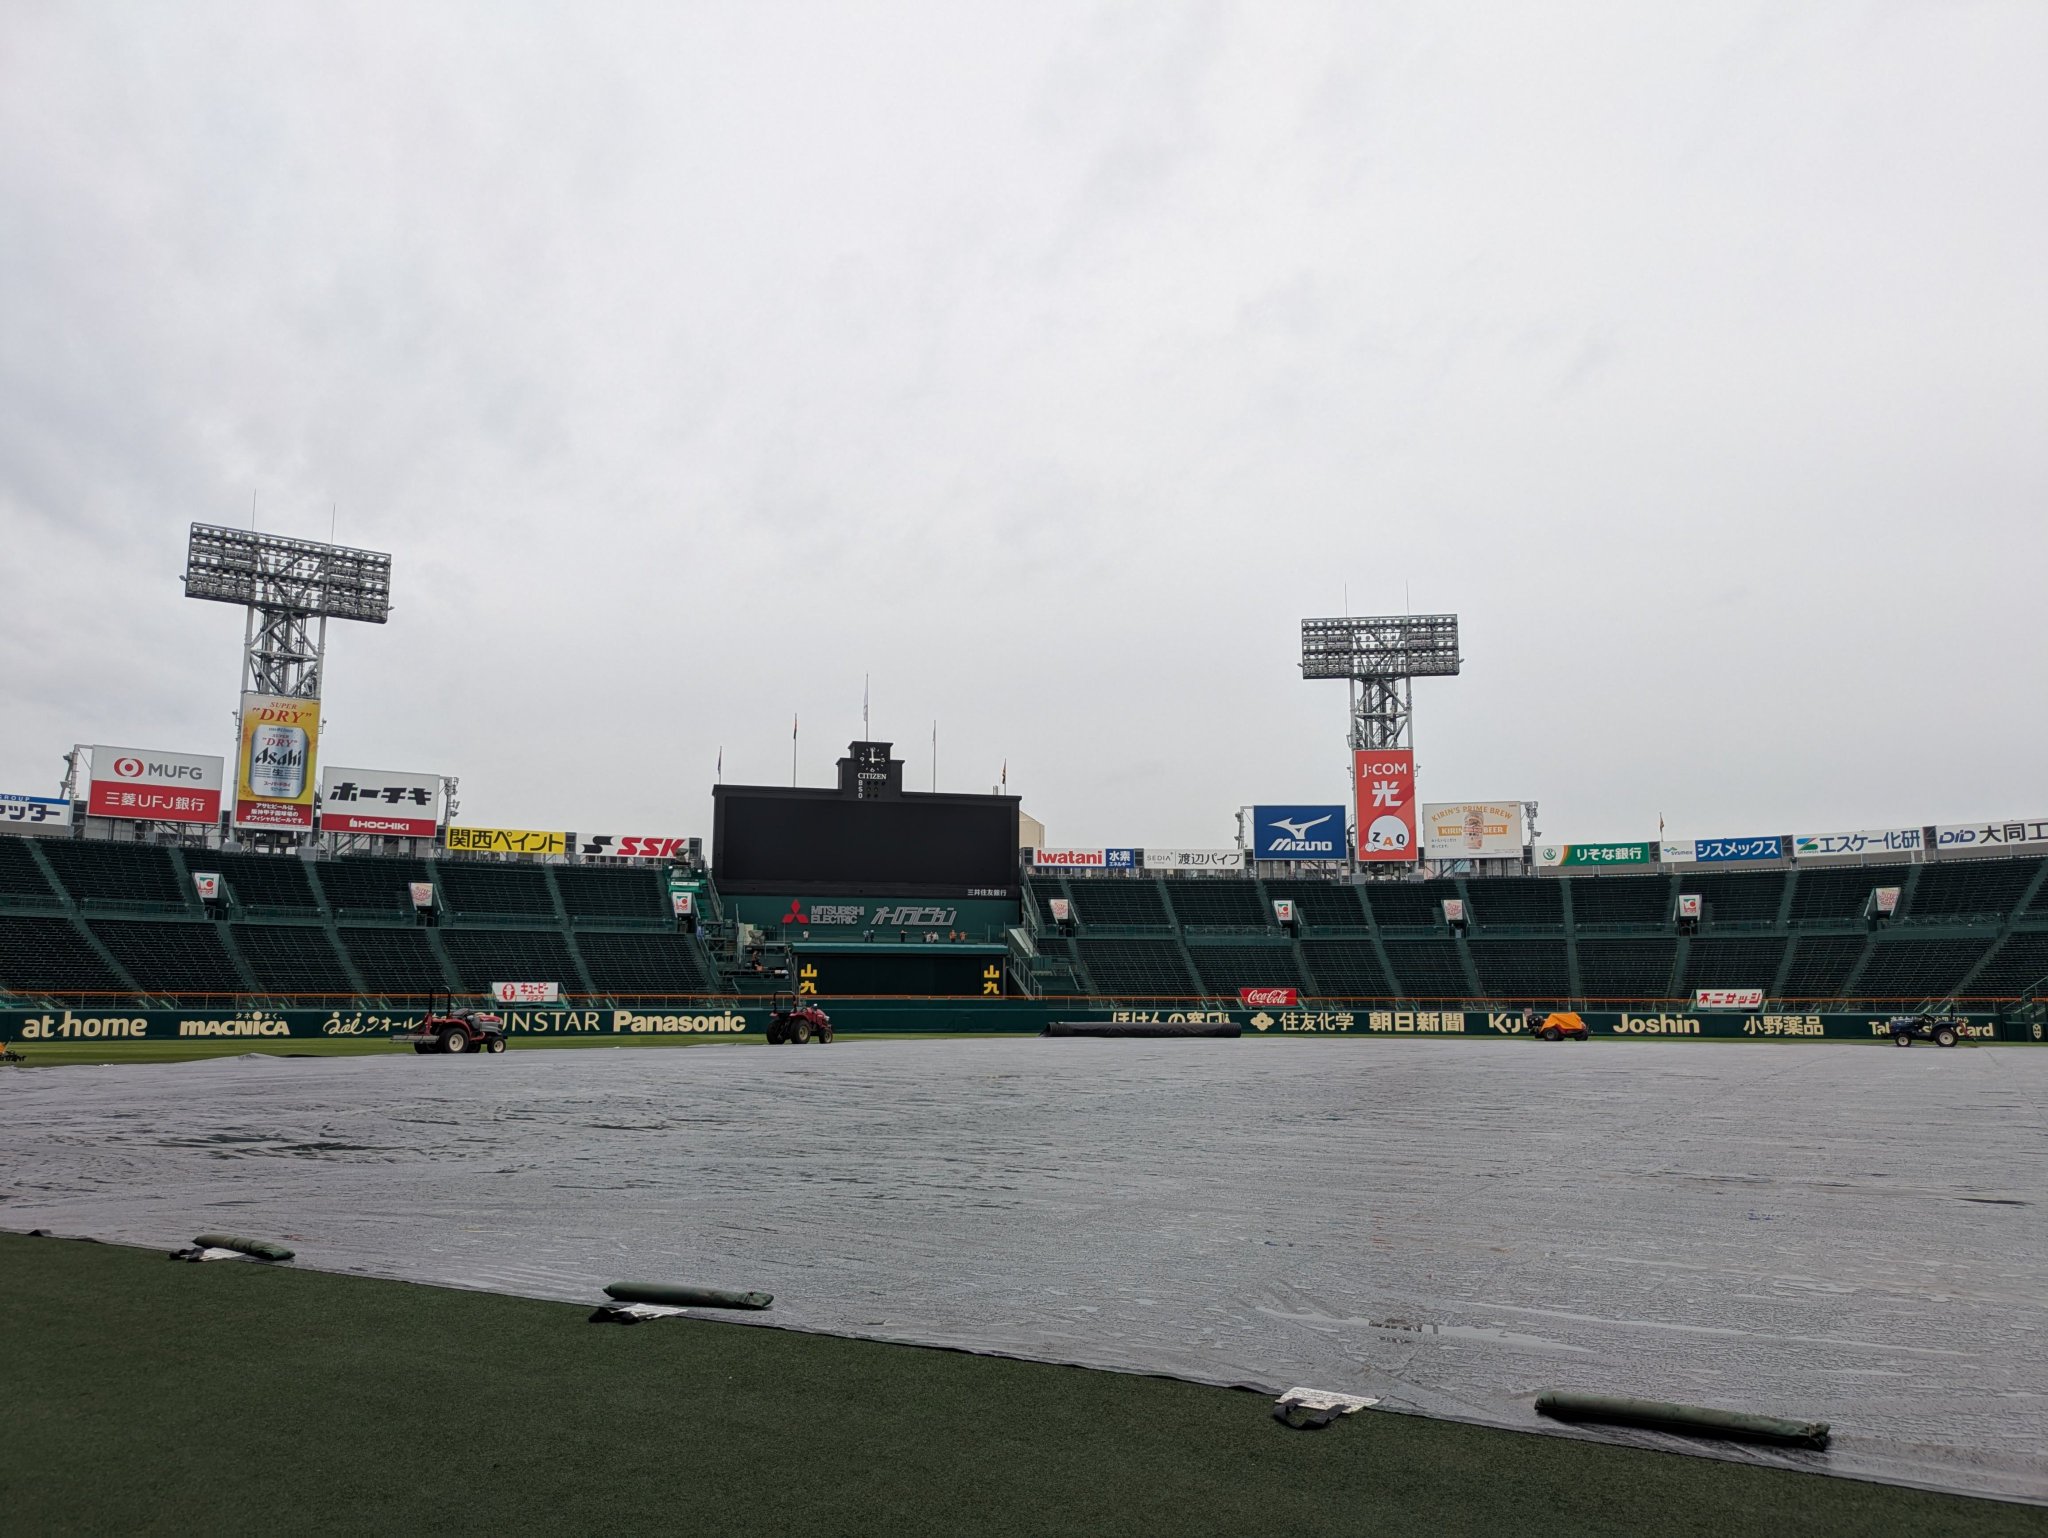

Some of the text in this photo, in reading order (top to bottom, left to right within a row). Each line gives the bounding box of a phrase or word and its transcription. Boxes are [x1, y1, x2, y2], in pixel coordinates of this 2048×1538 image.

[270, 701, 298, 710] SUPER
[255, 746, 302, 766] Asahi
[148, 763, 203, 780] MUFG
[857, 772, 887, 780] CITIZEN
[1362, 763, 1407, 777] J:COM
[0, 794, 30, 802] ROUP
[105, 791, 206, 812] 三菱UFJ銀行
[330, 782, 432, 806] ホーチキ
[1372, 780, 1403, 807] 光
[1431, 805, 1513, 822] KIRIN'S PRIME BREW
[358, 821, 409, 831] HOCHIKI
[1979, 821, 2048, 844] 大同工
[449, 828, 564, 853] 関西ペイント
[616, 837, 685, 857] SSK
[1268, 838, 1332, 851] MIZUNO
[1697, 839, 1779, 858] シスメックス
[1819, 830, 1920, 853] エスケー化研
[1037, 850, 1103, 864] Iwatani
[1109, 851, 1131, 861] 水素
[1576, 847, 1642, 861] りそな銀行
[967, 888, 1007, 897] 三井住友銀行
[811, 905, 865, 915] MITSUBISHI
[811, 914, 858, 925] ELECTRIC
[520, 982, 549, 995] キューピー
[1247, 989, 1289, 1005] Coca-Cola
[1699, 992, 1761, 1005] 不二サッシ
[22, 1011, 148, 1038] at home
[613, 1011, 746, 1032] Panasonic
[1280, 1012, 1354, 1031] 住友化学
[1369, 1012, 1465, 1032] 朝日新聞
[1613, 1013, 1700, 1034] Joshin
[1743, 1015, 1824, 1035] 小野薬品
